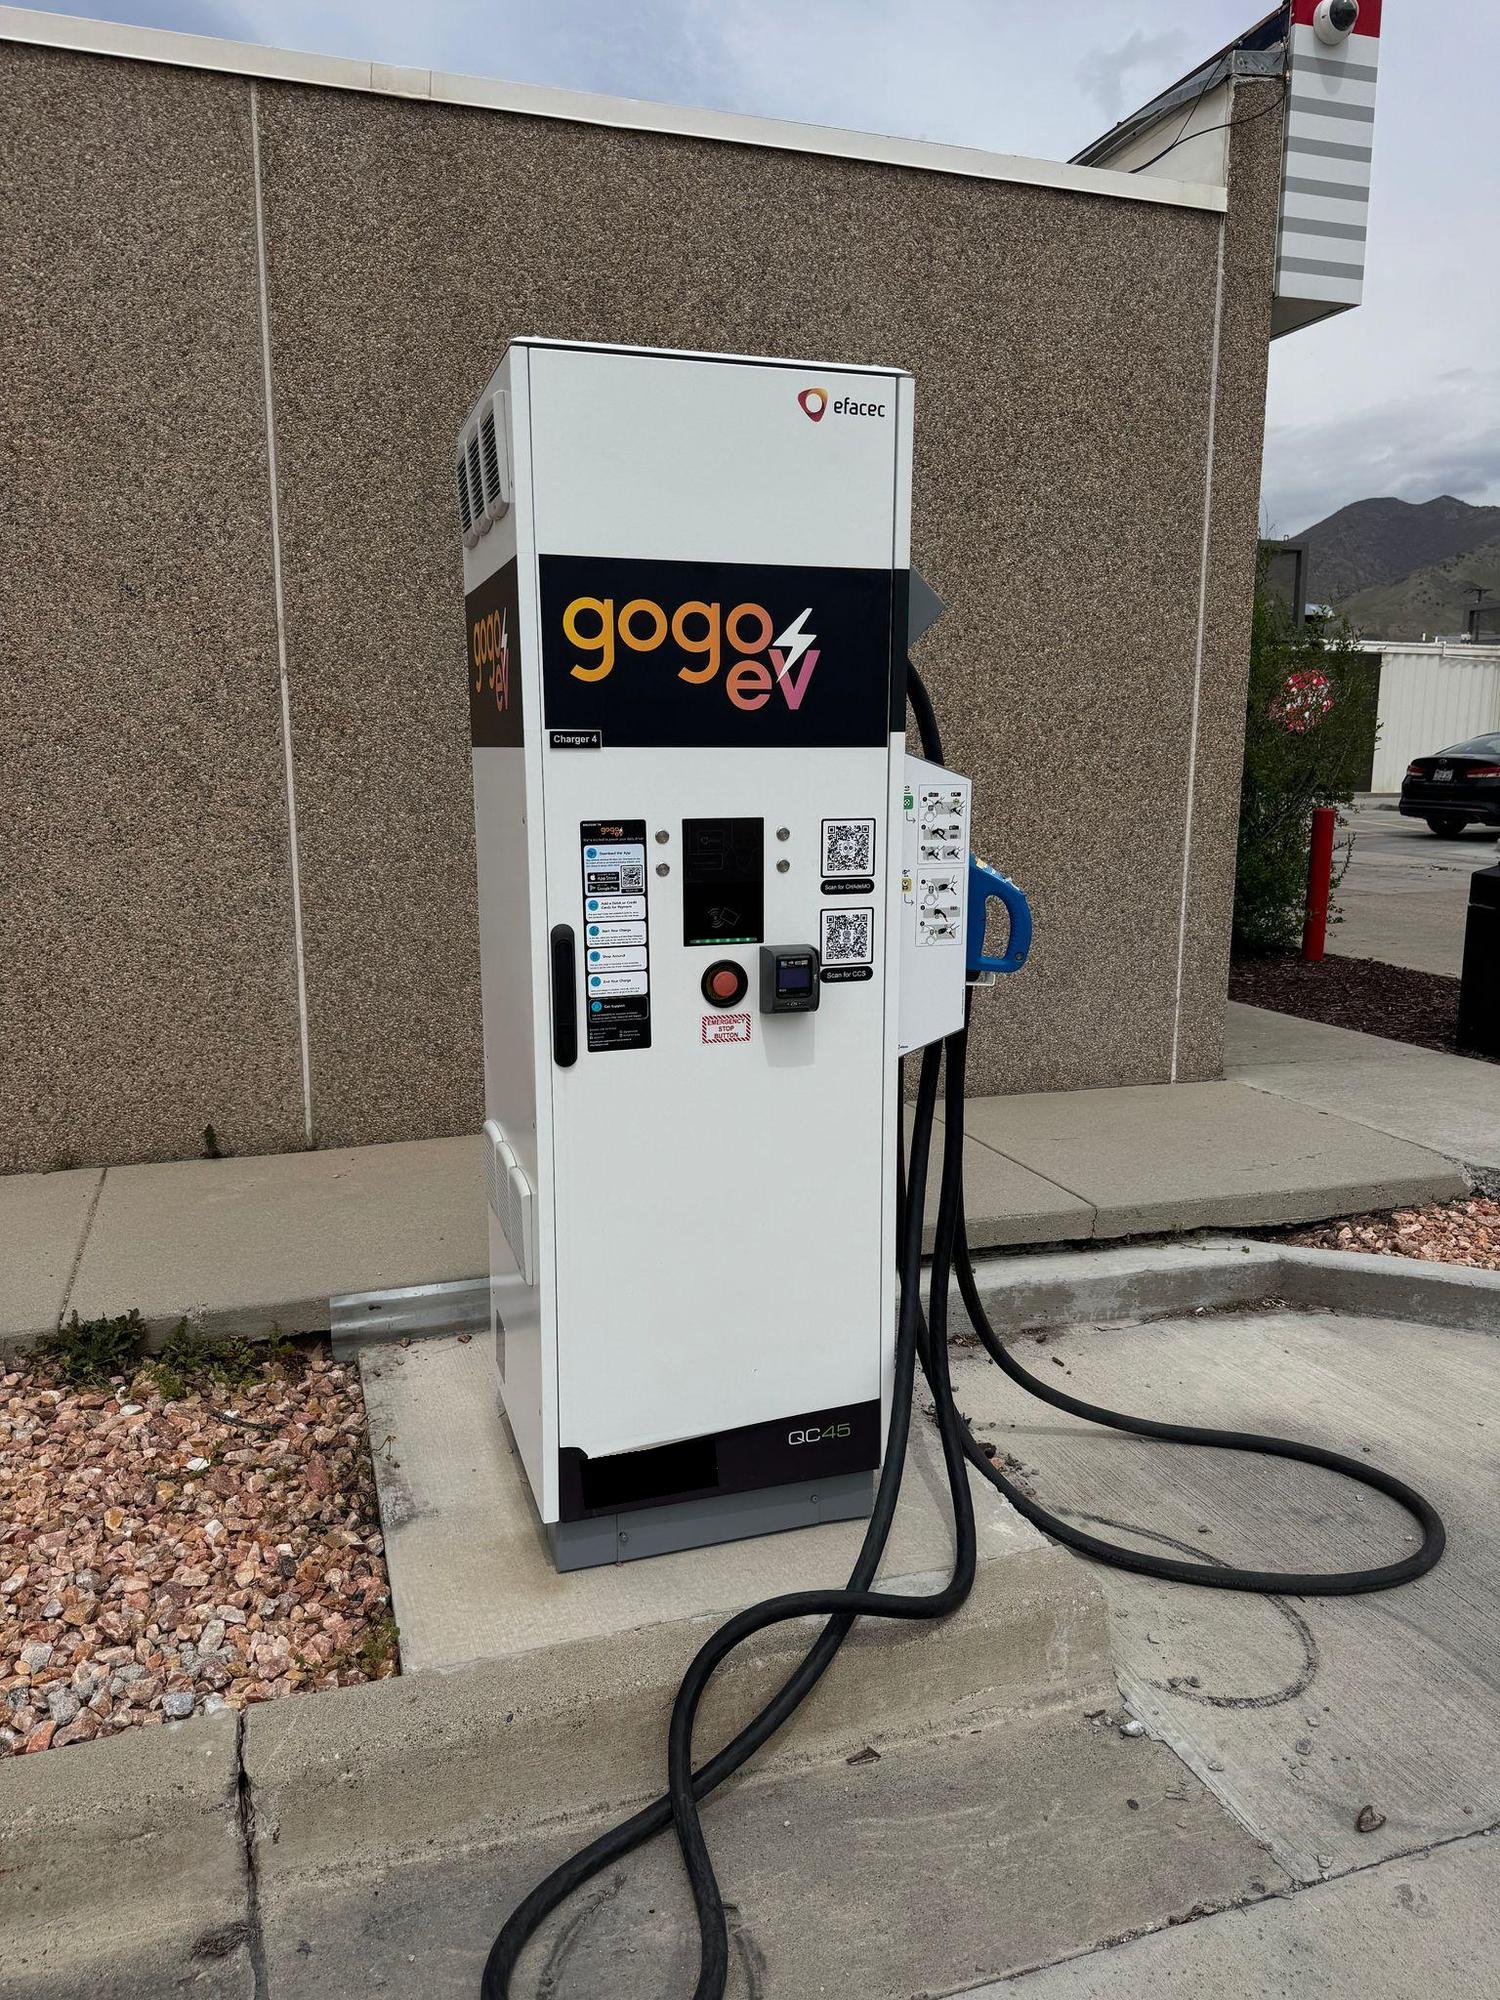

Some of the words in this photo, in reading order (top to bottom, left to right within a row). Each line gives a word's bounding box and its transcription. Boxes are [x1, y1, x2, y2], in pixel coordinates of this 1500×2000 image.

[833, 397, 885, 417] efacec
[473, 609, 501, 694] gogo
[562, 597, 774, 683] gogo
[553, 734, 590, 745] Charger
[591, 734, 598, 743] 4
[788, 1422, 851, 1446] QC45
